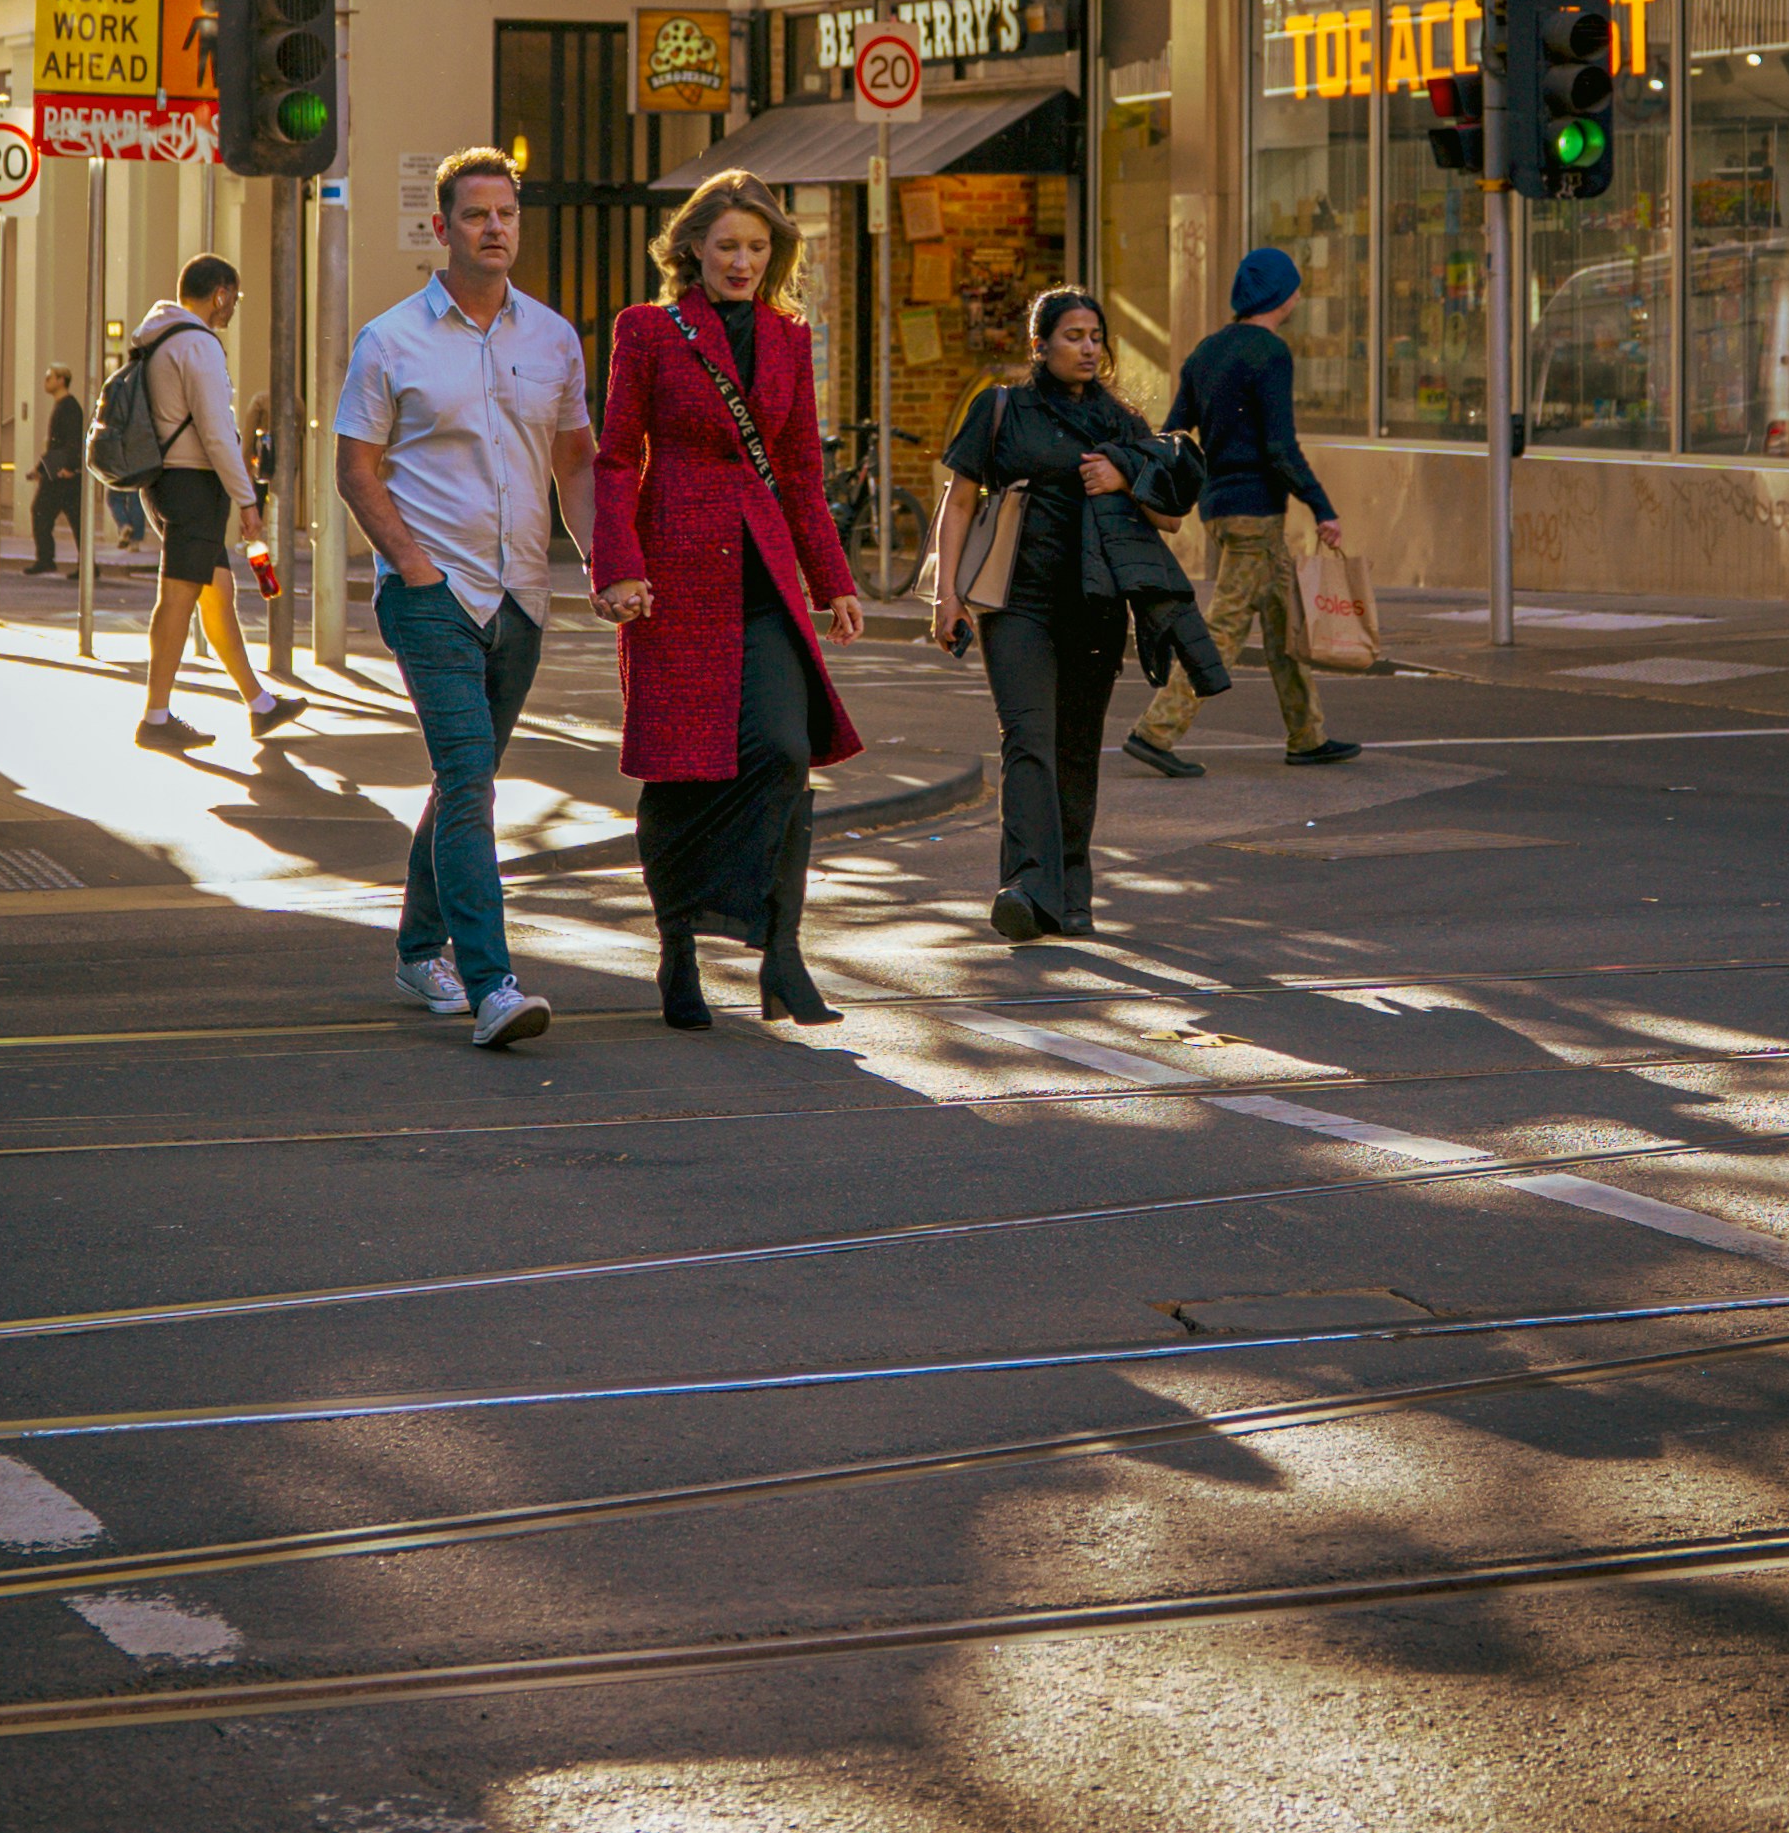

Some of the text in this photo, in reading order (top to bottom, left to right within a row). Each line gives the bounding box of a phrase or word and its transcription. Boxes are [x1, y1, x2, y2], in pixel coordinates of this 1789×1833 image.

[53, 11, 139, 44] WORK
[42, 50, 148, 83] AHEAD
[869, 55, 911, 90] 20
[168, 111, 196, 149] TO
[727, 395, 756, 437] LOVE
[747, 436, 771, 475] LOVE
[1314, 594, 1365, 617] coles
